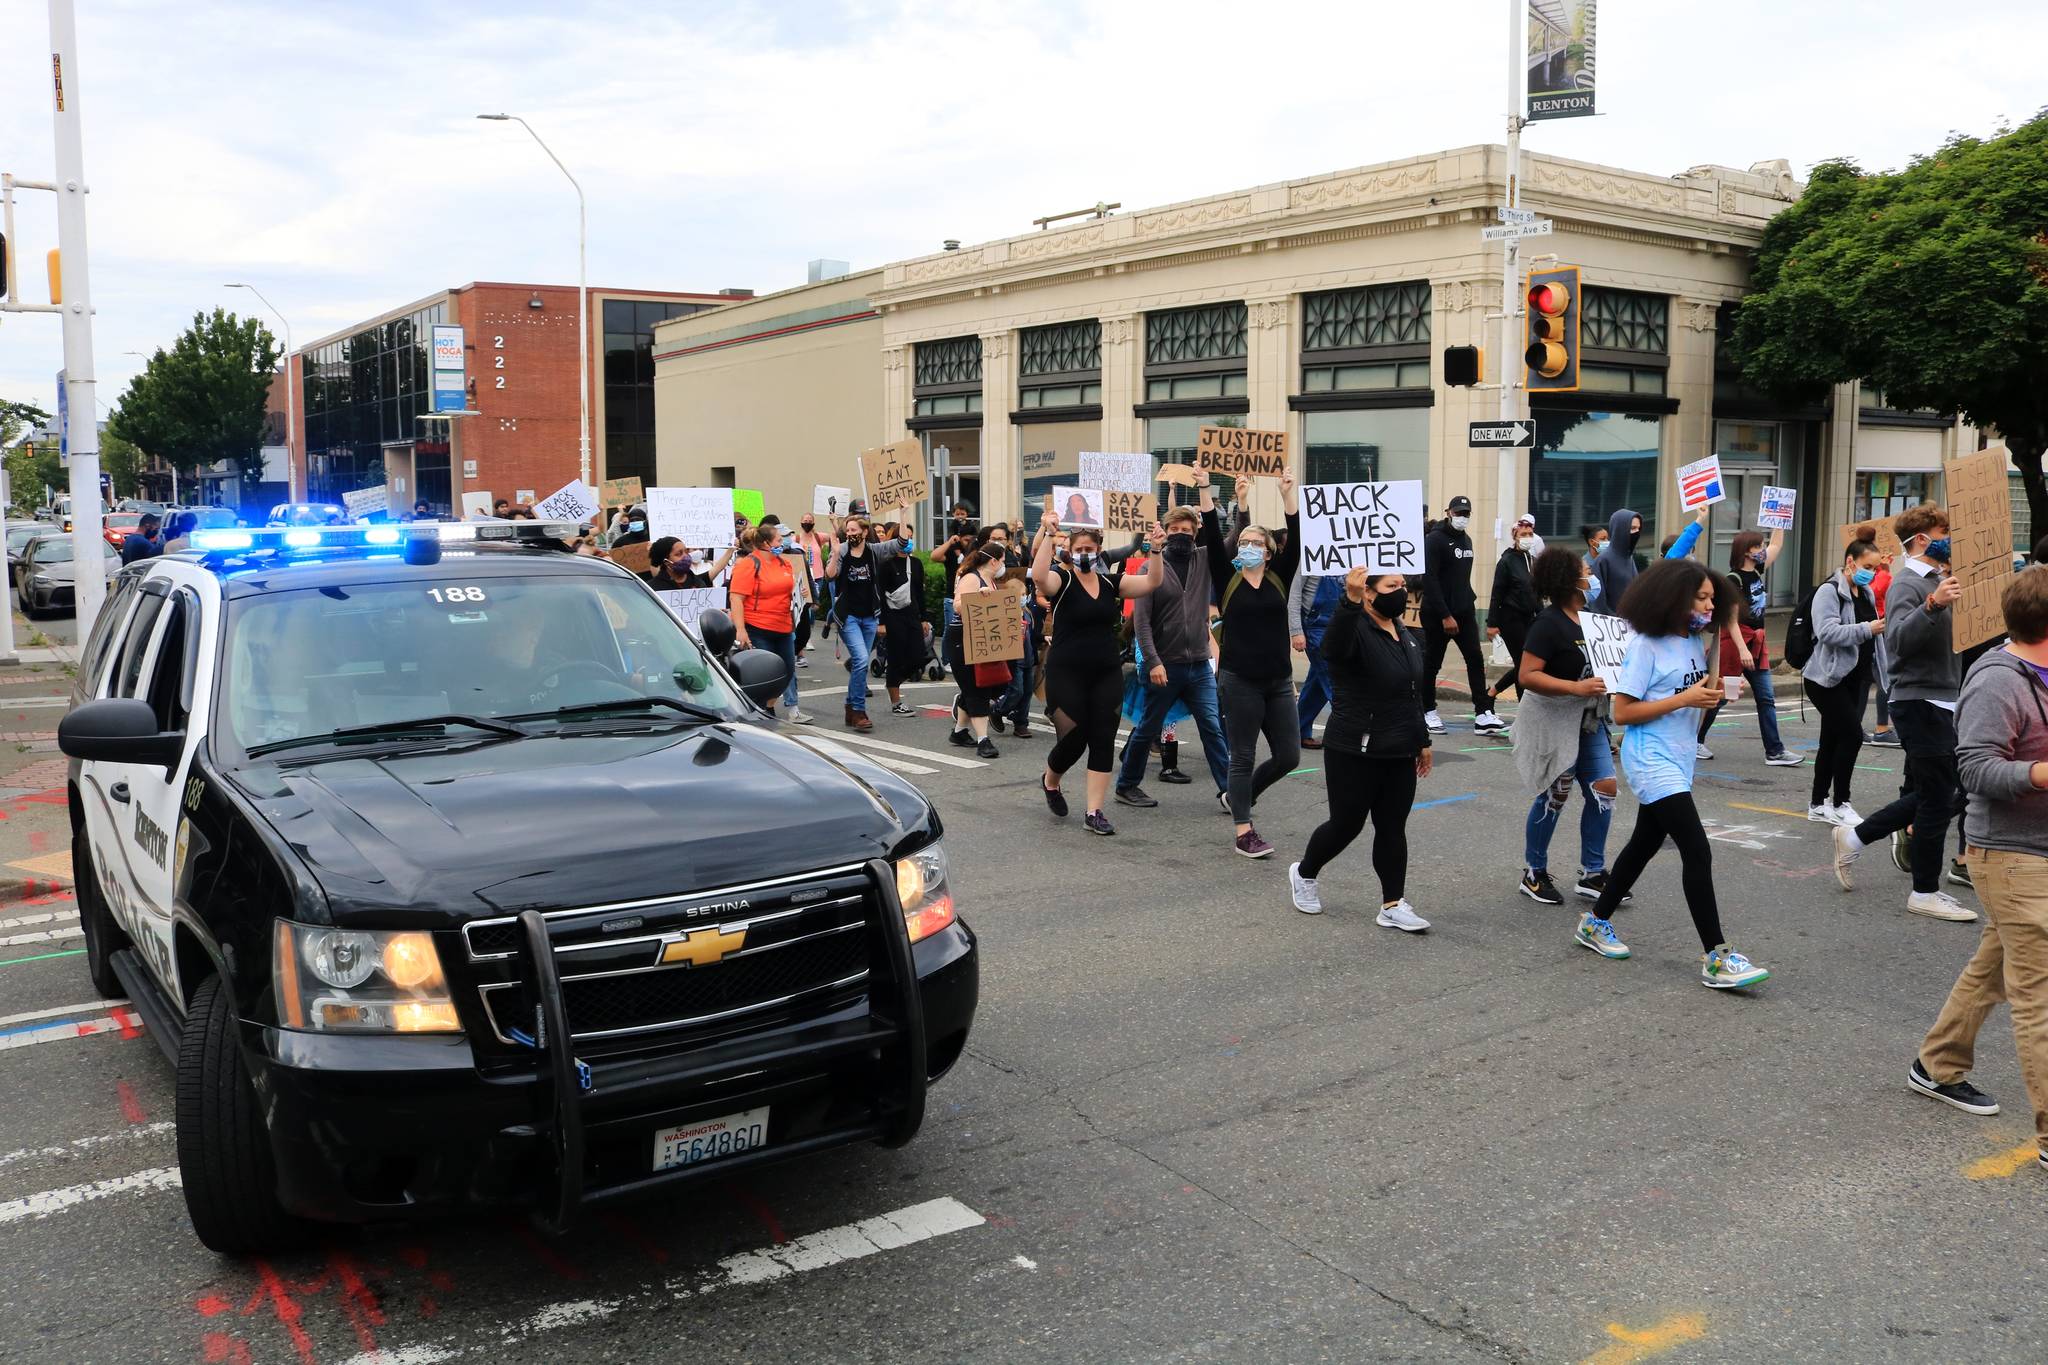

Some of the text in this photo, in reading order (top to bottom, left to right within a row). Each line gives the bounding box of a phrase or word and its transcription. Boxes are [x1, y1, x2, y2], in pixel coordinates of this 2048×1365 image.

[1532, 97, 1590, 112] RENTON
[1499, 209, 1534, 222] S Third St
[1485, 223, 1548, 239] Williams Ave S
[435, 339, 455, 347] HOT
[436, 347, 463, 355] YOGA
[1202, 429, 1284, 453] JUSTICE
[1473, 428, 1513, 440] ONE WAY
[1201, 451, 1284, 475] BREONNA
[877, 464, 911, 486] CAN'T
[1952, 467, 1963, 494] I
[1967, 457, 1993, 491] SEE
[543, 489, 573, 513] BLACK
[1109, 492, 1143, 507] SAY
[1303, 484, 1389, 520] BLACK
[1109, 505, 1144, 519] HER
[1949, 503, 1961, 532] I
[1963, 496, 1993, 528] HEAR
[1108, 518, 1154, 532] NAME
[1329, 513, 1400, 542] LIVES
[1304, 541, 1415, 572] MATTER
[1953, 520, 2010, 573] I STAND
[427, 586, 486, 603] 188
[670, 589, 713, 607] BLACK
[969, 603, 989, 658] MATTER
[986, 604, 1003, 652] LIVES
[1003, 595, 1019, 649] BLACK
[1591, 613, 1629, 643] STOP
[1690, 658, 1697, 670] I
[184, 776, 205, 812] 188
[686, 899, 750, 918] SETINA
[664, 1121, 727, 1142] WASHINGTON
[675, 1123, 762, 1167] 56486D
